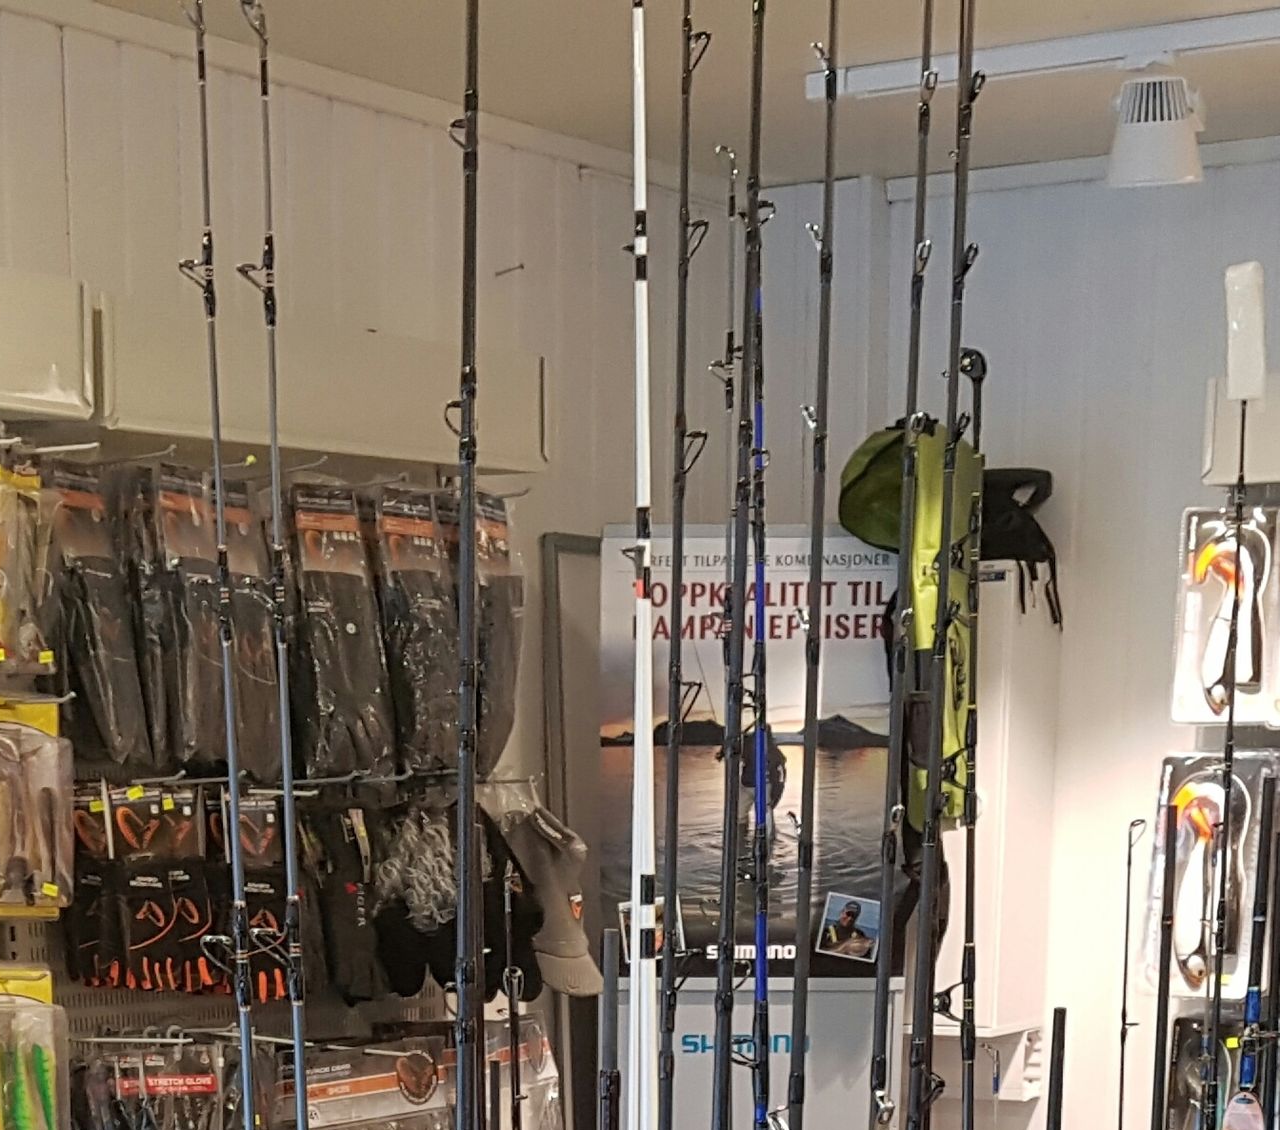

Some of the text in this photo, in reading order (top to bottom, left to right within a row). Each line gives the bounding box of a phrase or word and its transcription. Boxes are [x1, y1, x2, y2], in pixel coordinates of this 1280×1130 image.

[848, 581, 888, 606] TIL
[148, 1075, 212, 1088] STRETCH GLOVE
